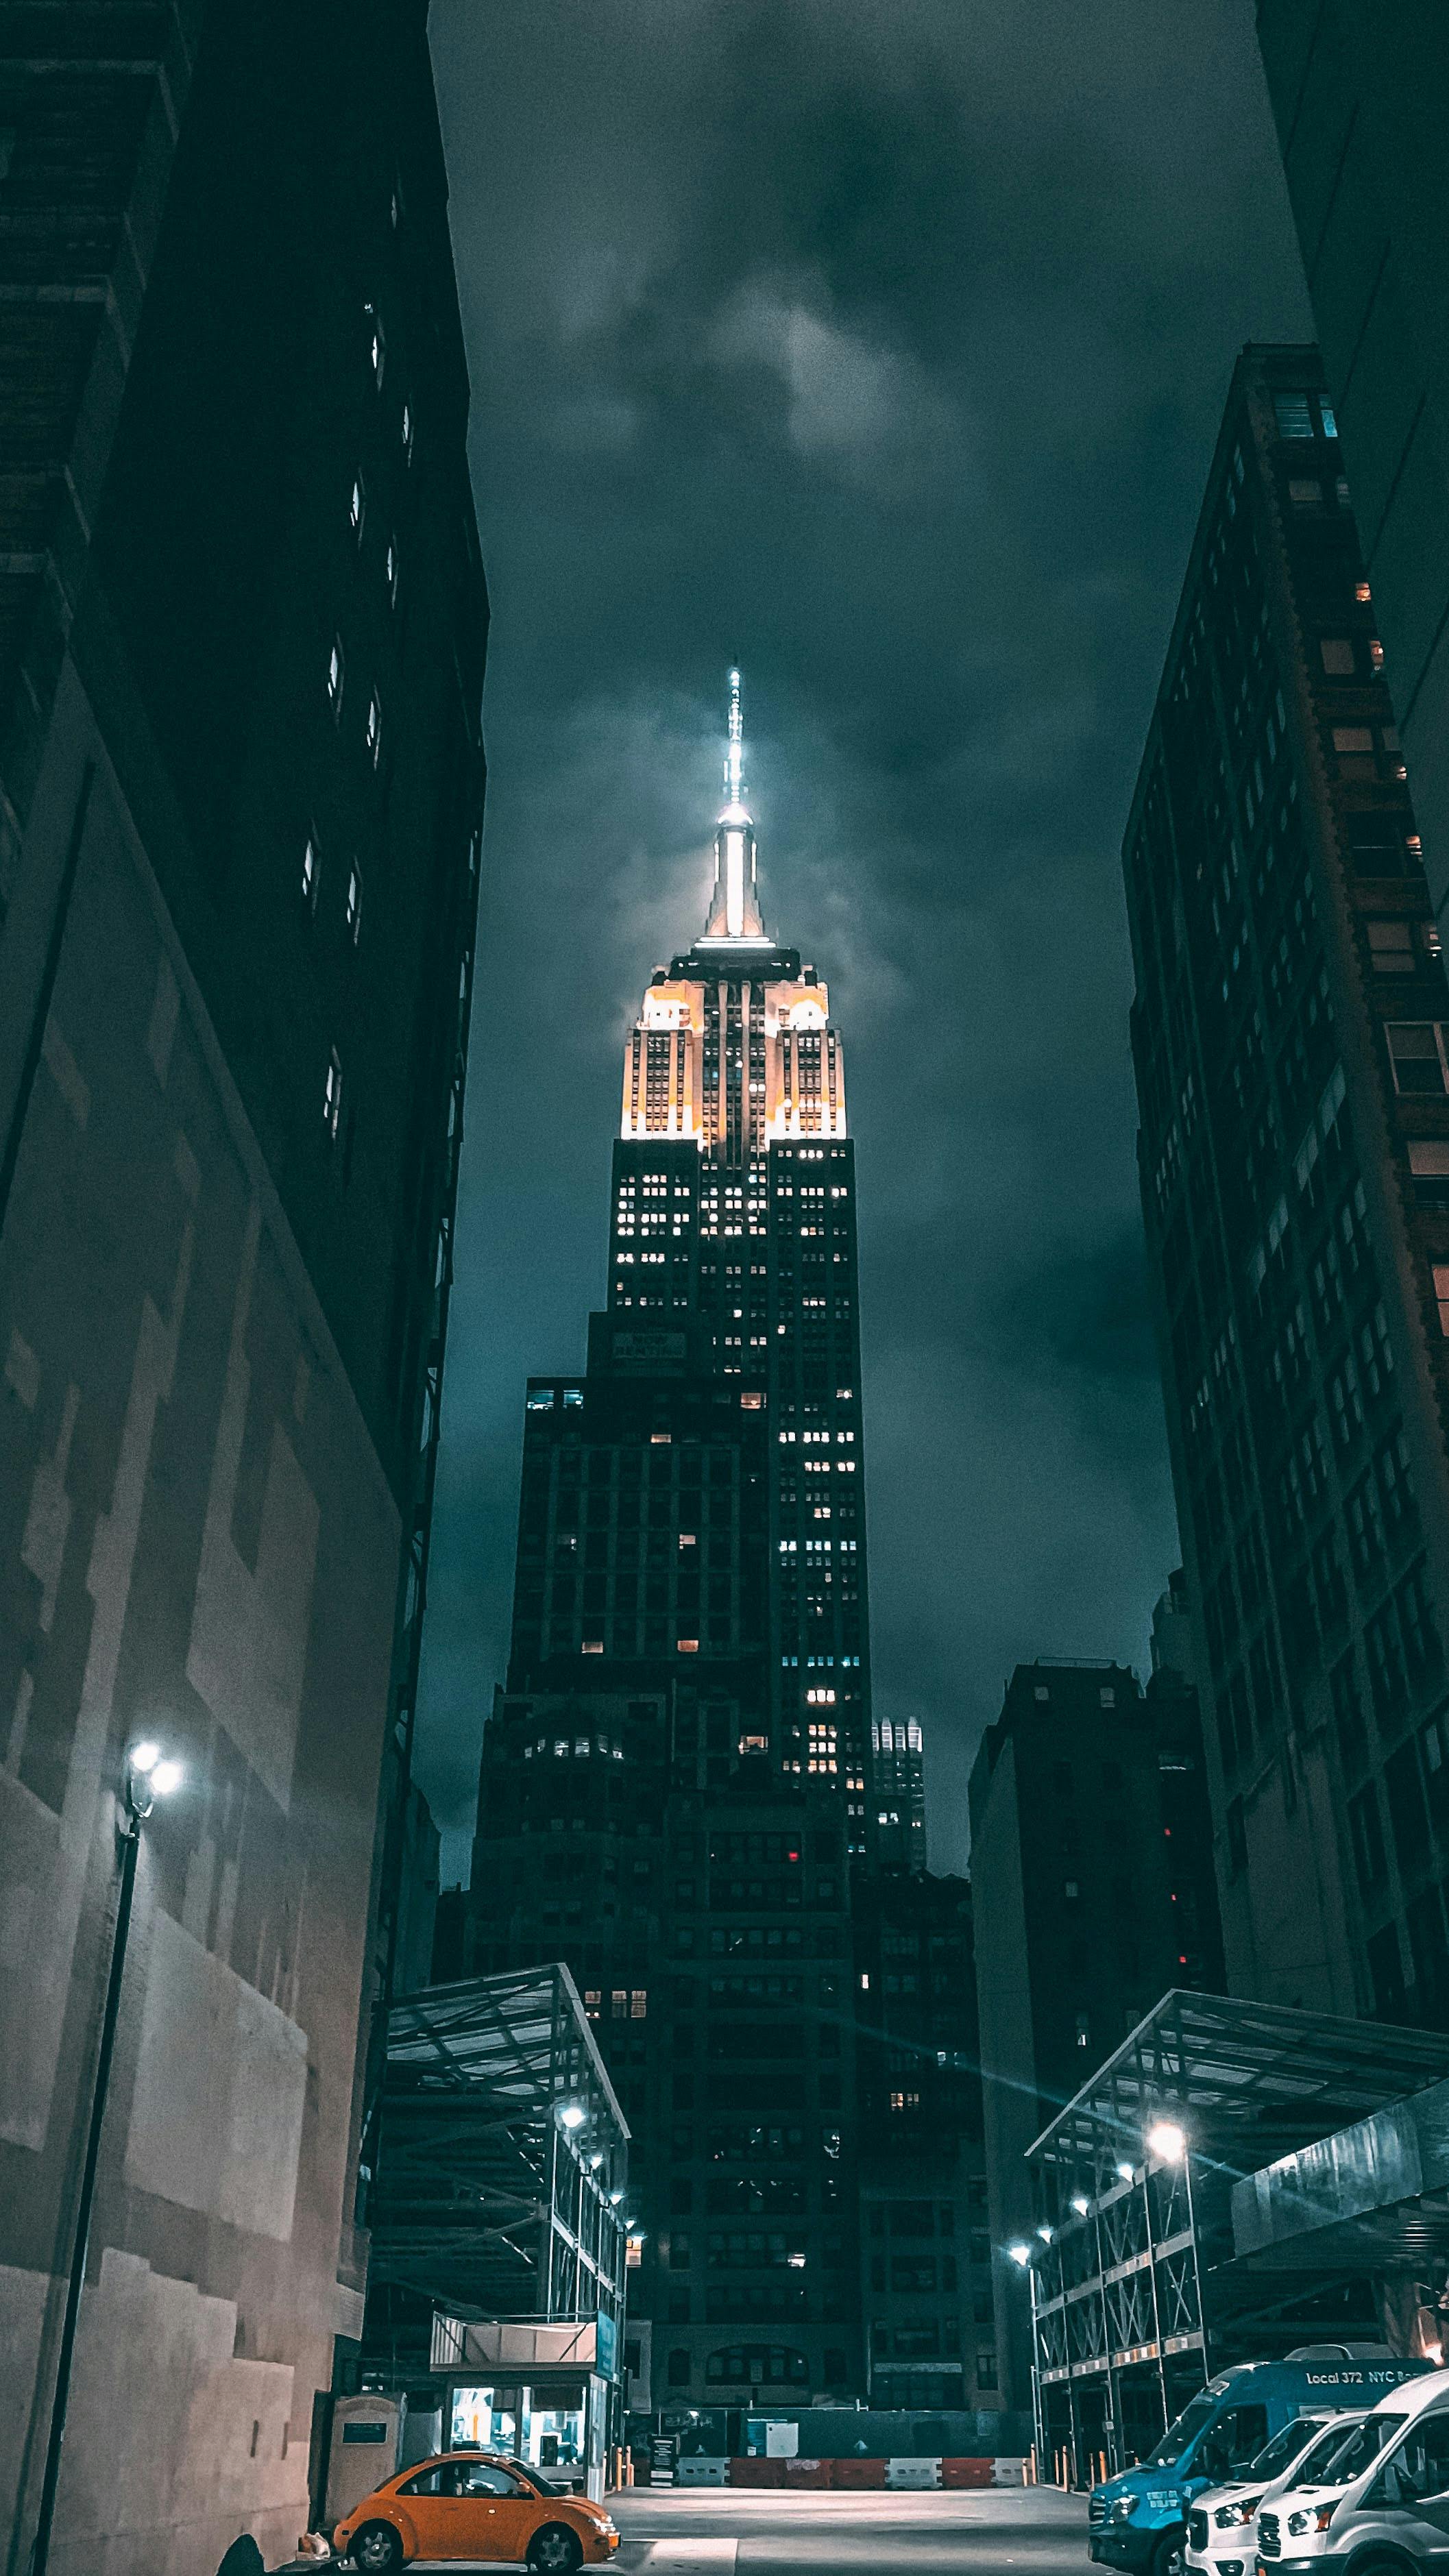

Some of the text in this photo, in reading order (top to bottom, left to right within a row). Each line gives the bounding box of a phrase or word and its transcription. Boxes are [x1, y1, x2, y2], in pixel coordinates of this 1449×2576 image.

[1306, 2372, 1339, 2383] Local
[1341, 2372, 1363, 2383] 372
[1369, 2371, 1395, 2383] NYC
